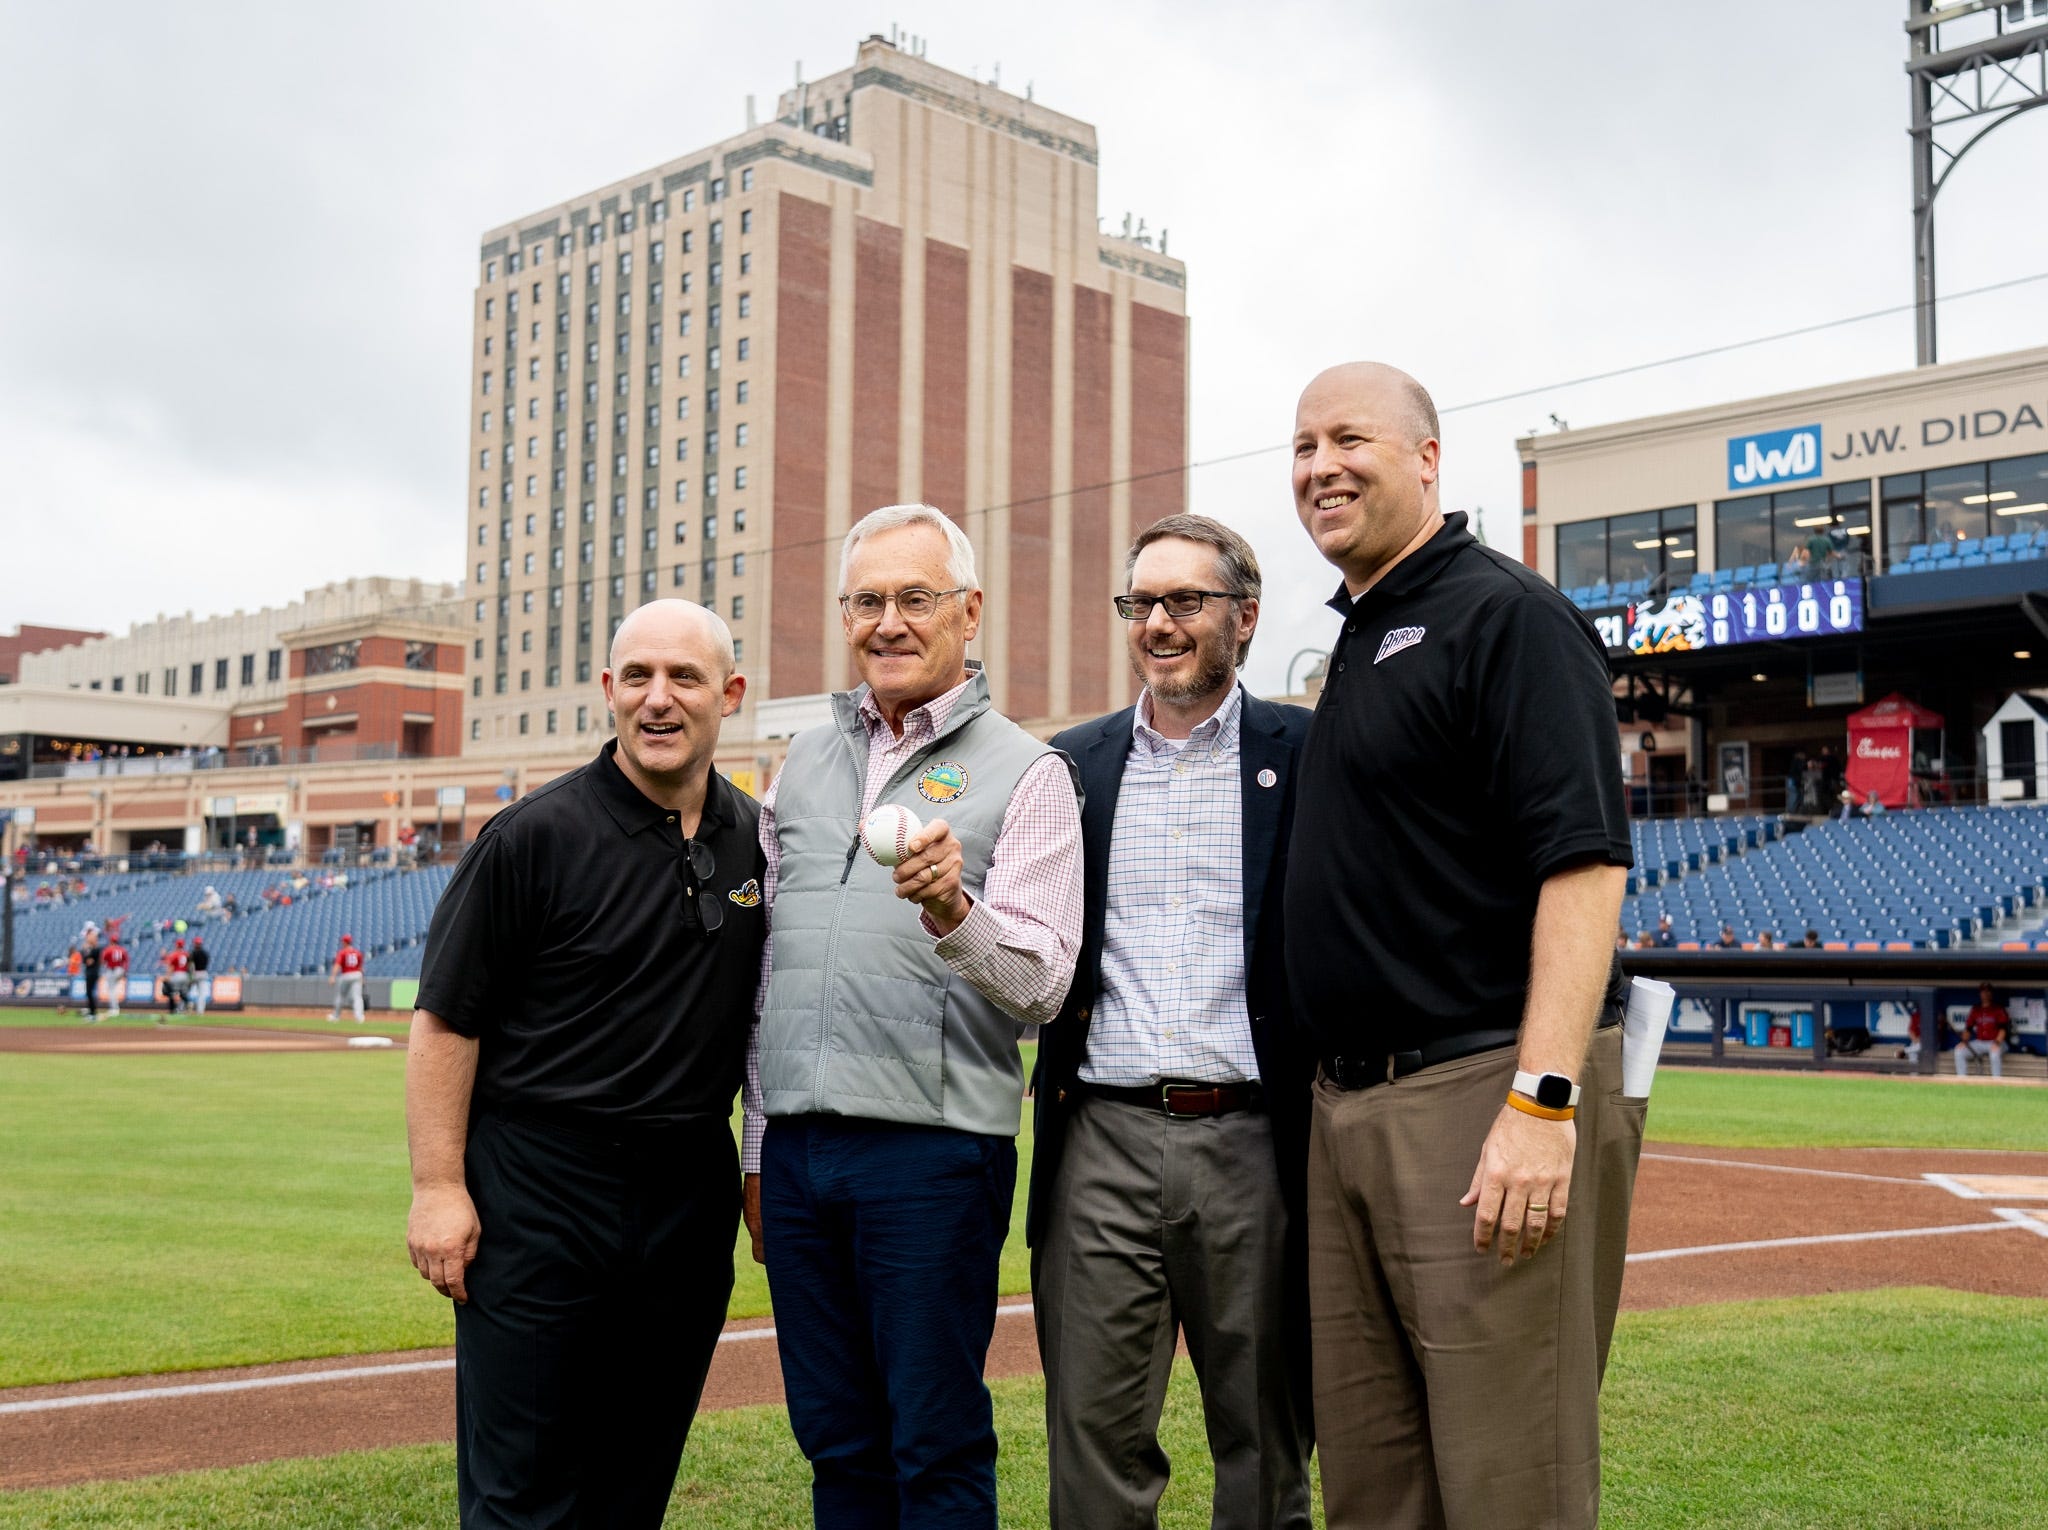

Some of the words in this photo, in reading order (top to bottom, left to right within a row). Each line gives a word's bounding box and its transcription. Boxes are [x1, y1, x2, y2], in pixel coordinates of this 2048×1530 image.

[1830, 425, 1907, 461] J.W.
[1922, 404, 2048, 447] DIDA
[1766, 602, 1787, 635] 0
[1798, 599, 1819, 631] 0
[1830, 595, 1851, 628] 0
